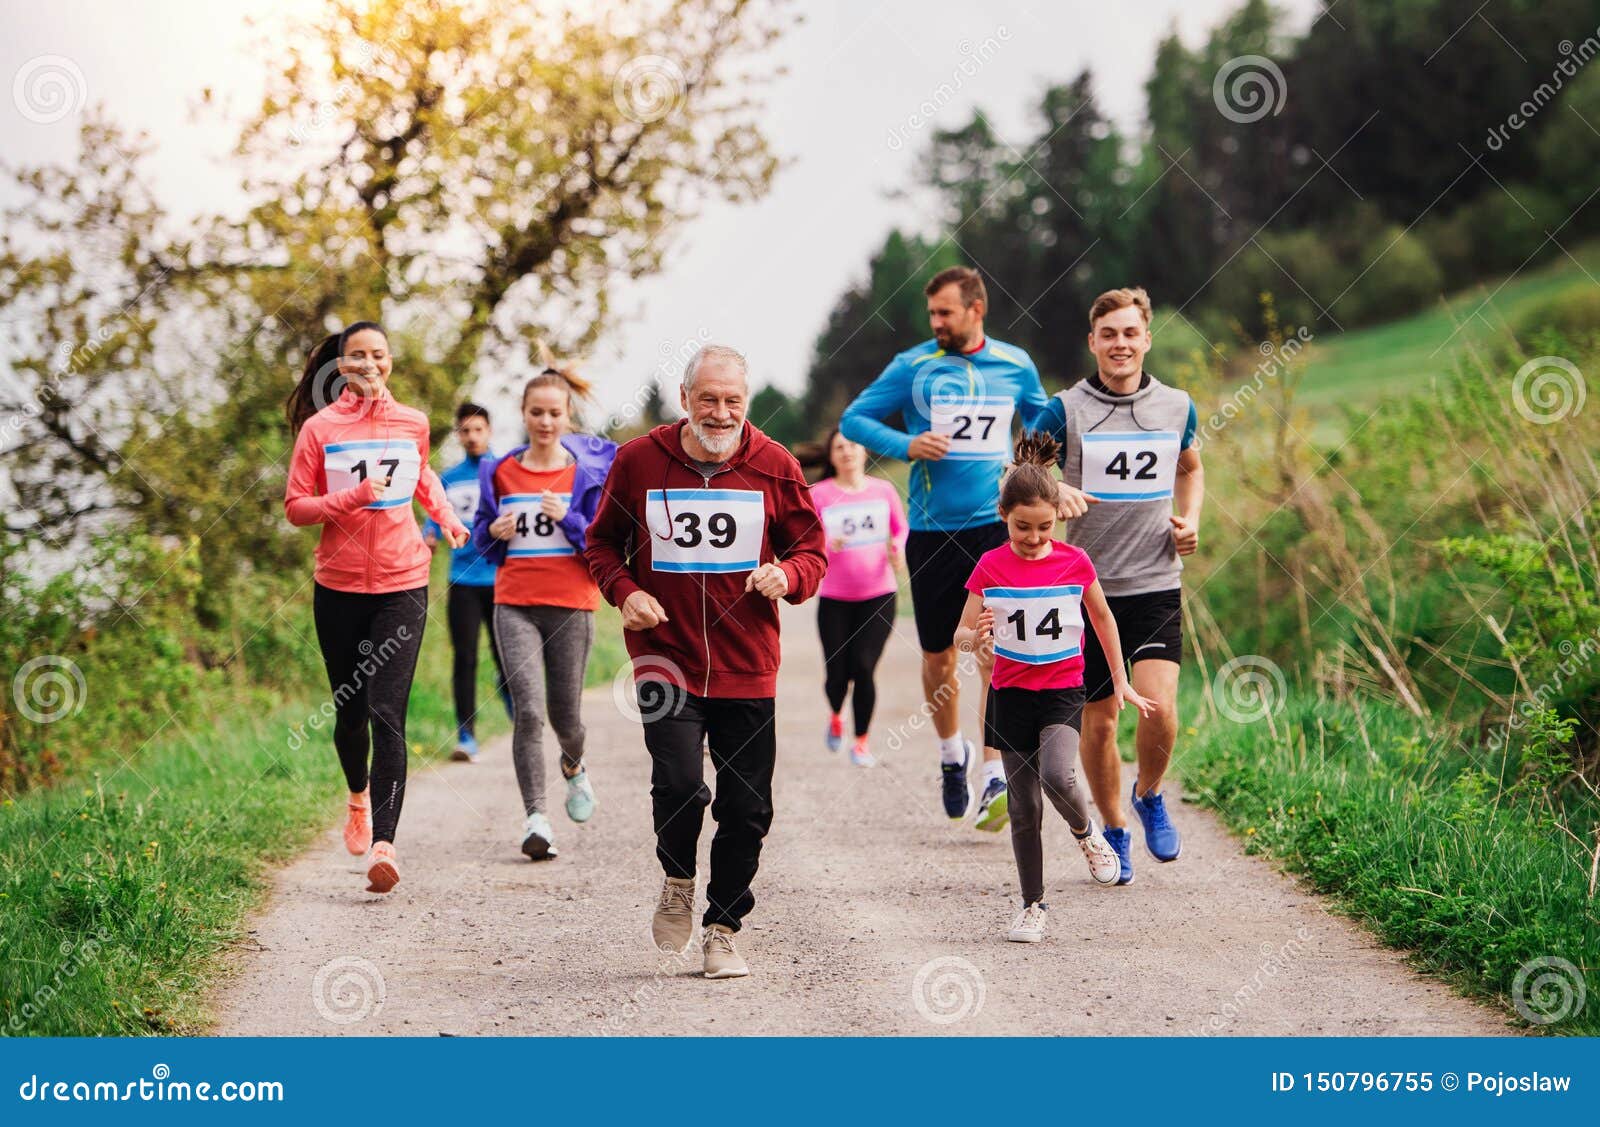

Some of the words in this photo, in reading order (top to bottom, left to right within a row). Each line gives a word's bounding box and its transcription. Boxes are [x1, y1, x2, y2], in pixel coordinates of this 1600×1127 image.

[952, 415, 996, 441] 27
[350, 458, 400, 488] 17
[1105, 450, 1158, 480] 42
[515, 512, 555, 537] 48
[673, 511, 737, 549] 39
[1007, 607, 1063, 642] 14
